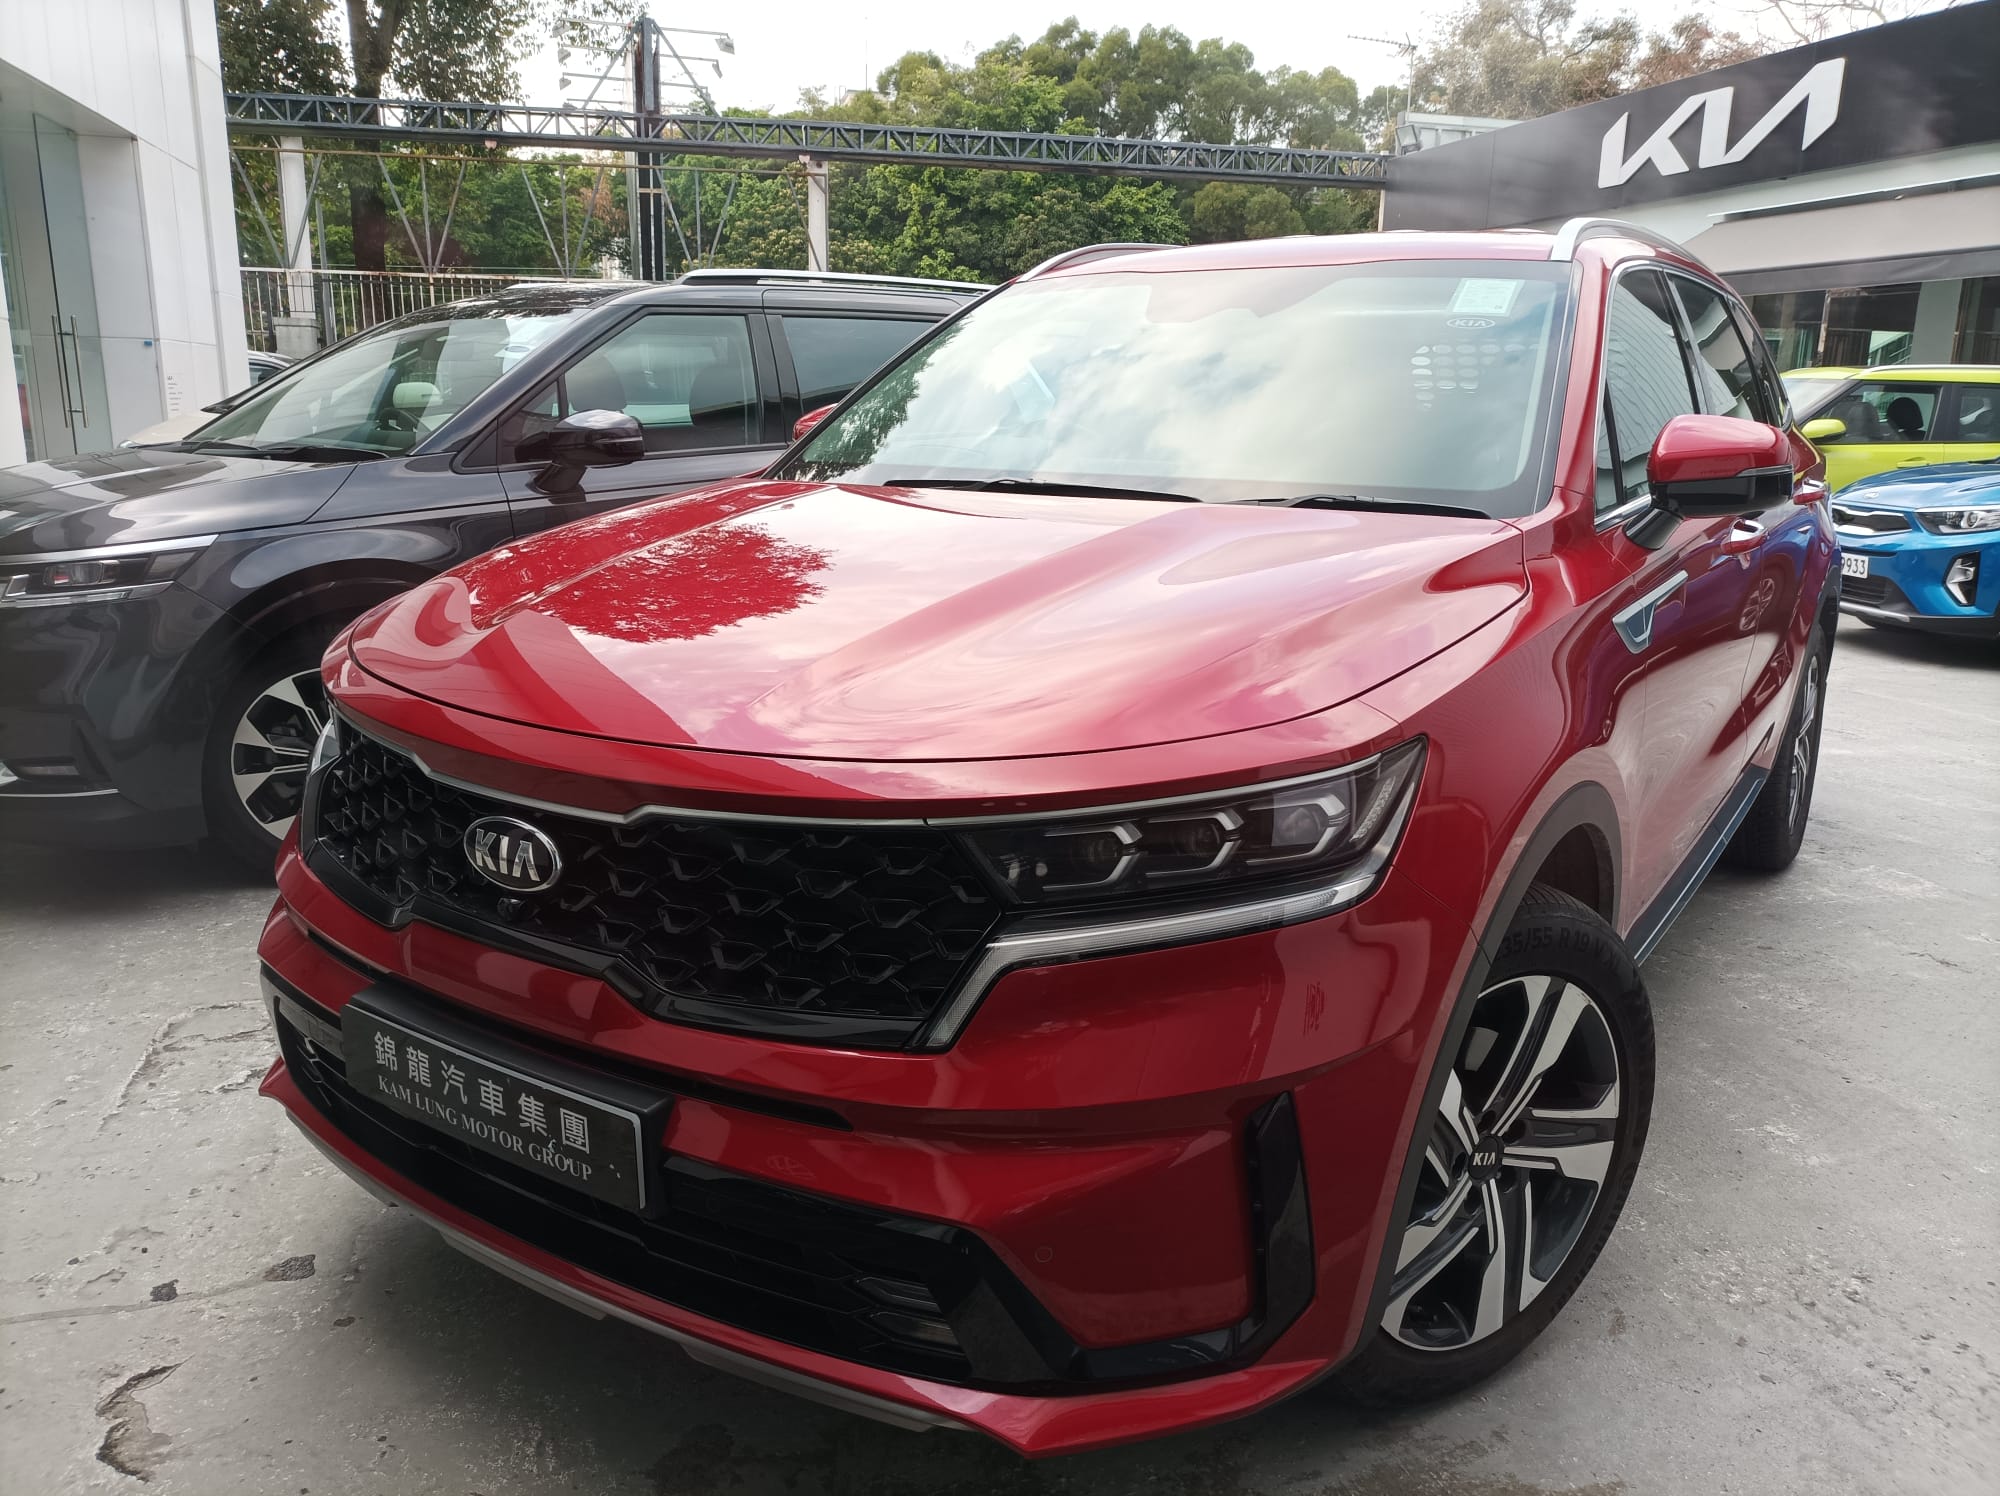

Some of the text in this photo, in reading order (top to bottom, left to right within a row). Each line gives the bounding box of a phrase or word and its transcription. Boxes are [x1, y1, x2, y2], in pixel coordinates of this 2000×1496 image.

[1454, 319, 1487, 328] KIA
[475, 828, 540, 881] KIA
[1496, 926, 1553, 959] 35/55
[374, 1031, 590, 1154] 錦龍汽車集團
[377, 1075, 592, 1181] KAM LUNG MOTOR GROUP
[1472, 1152, 1496, 1166] KIA
